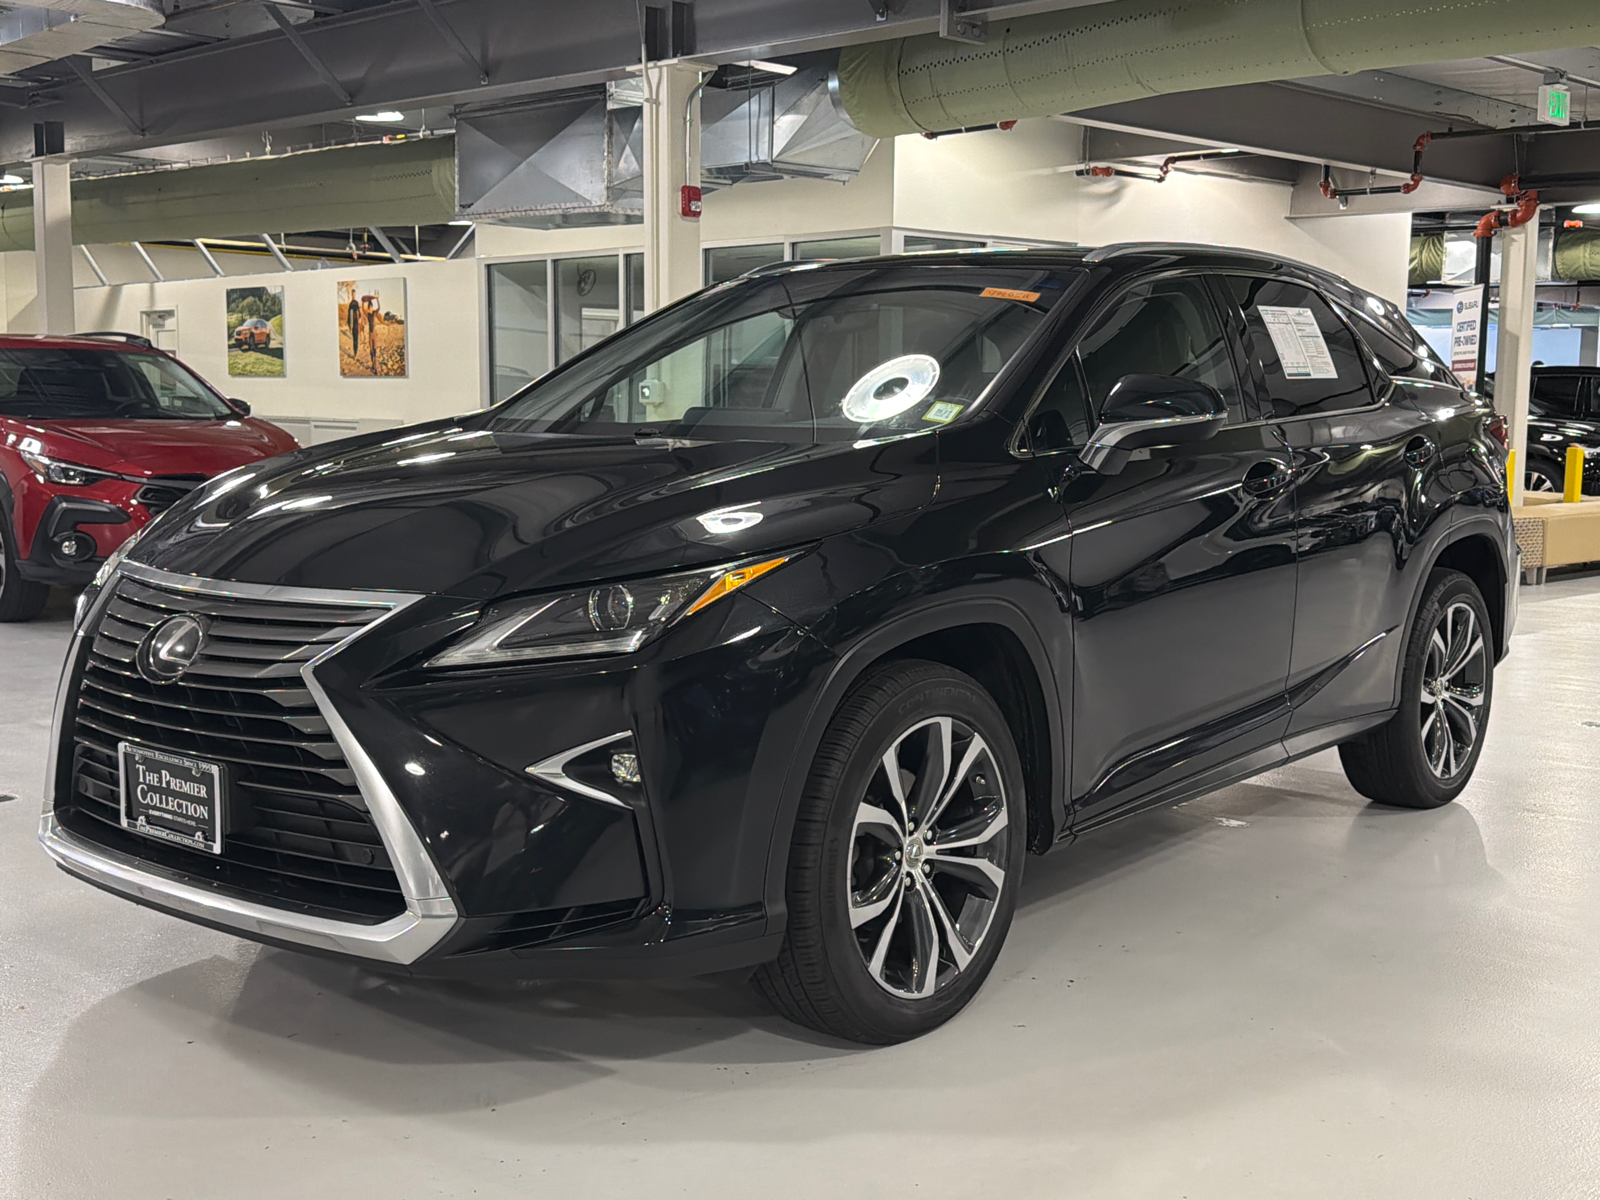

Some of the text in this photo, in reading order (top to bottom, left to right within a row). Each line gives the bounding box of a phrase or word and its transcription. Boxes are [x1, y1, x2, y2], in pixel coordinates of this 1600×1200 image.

[1464, 300, 1479, 310] SUBARU
[1456, 320, 1477, 333] CERTIFIED
[1454, 334, 1477, 347] PRE-OWNED
[136, 764, 208, 798] THE PREMIER
[136, 784, 209, 820] COLLECTION
